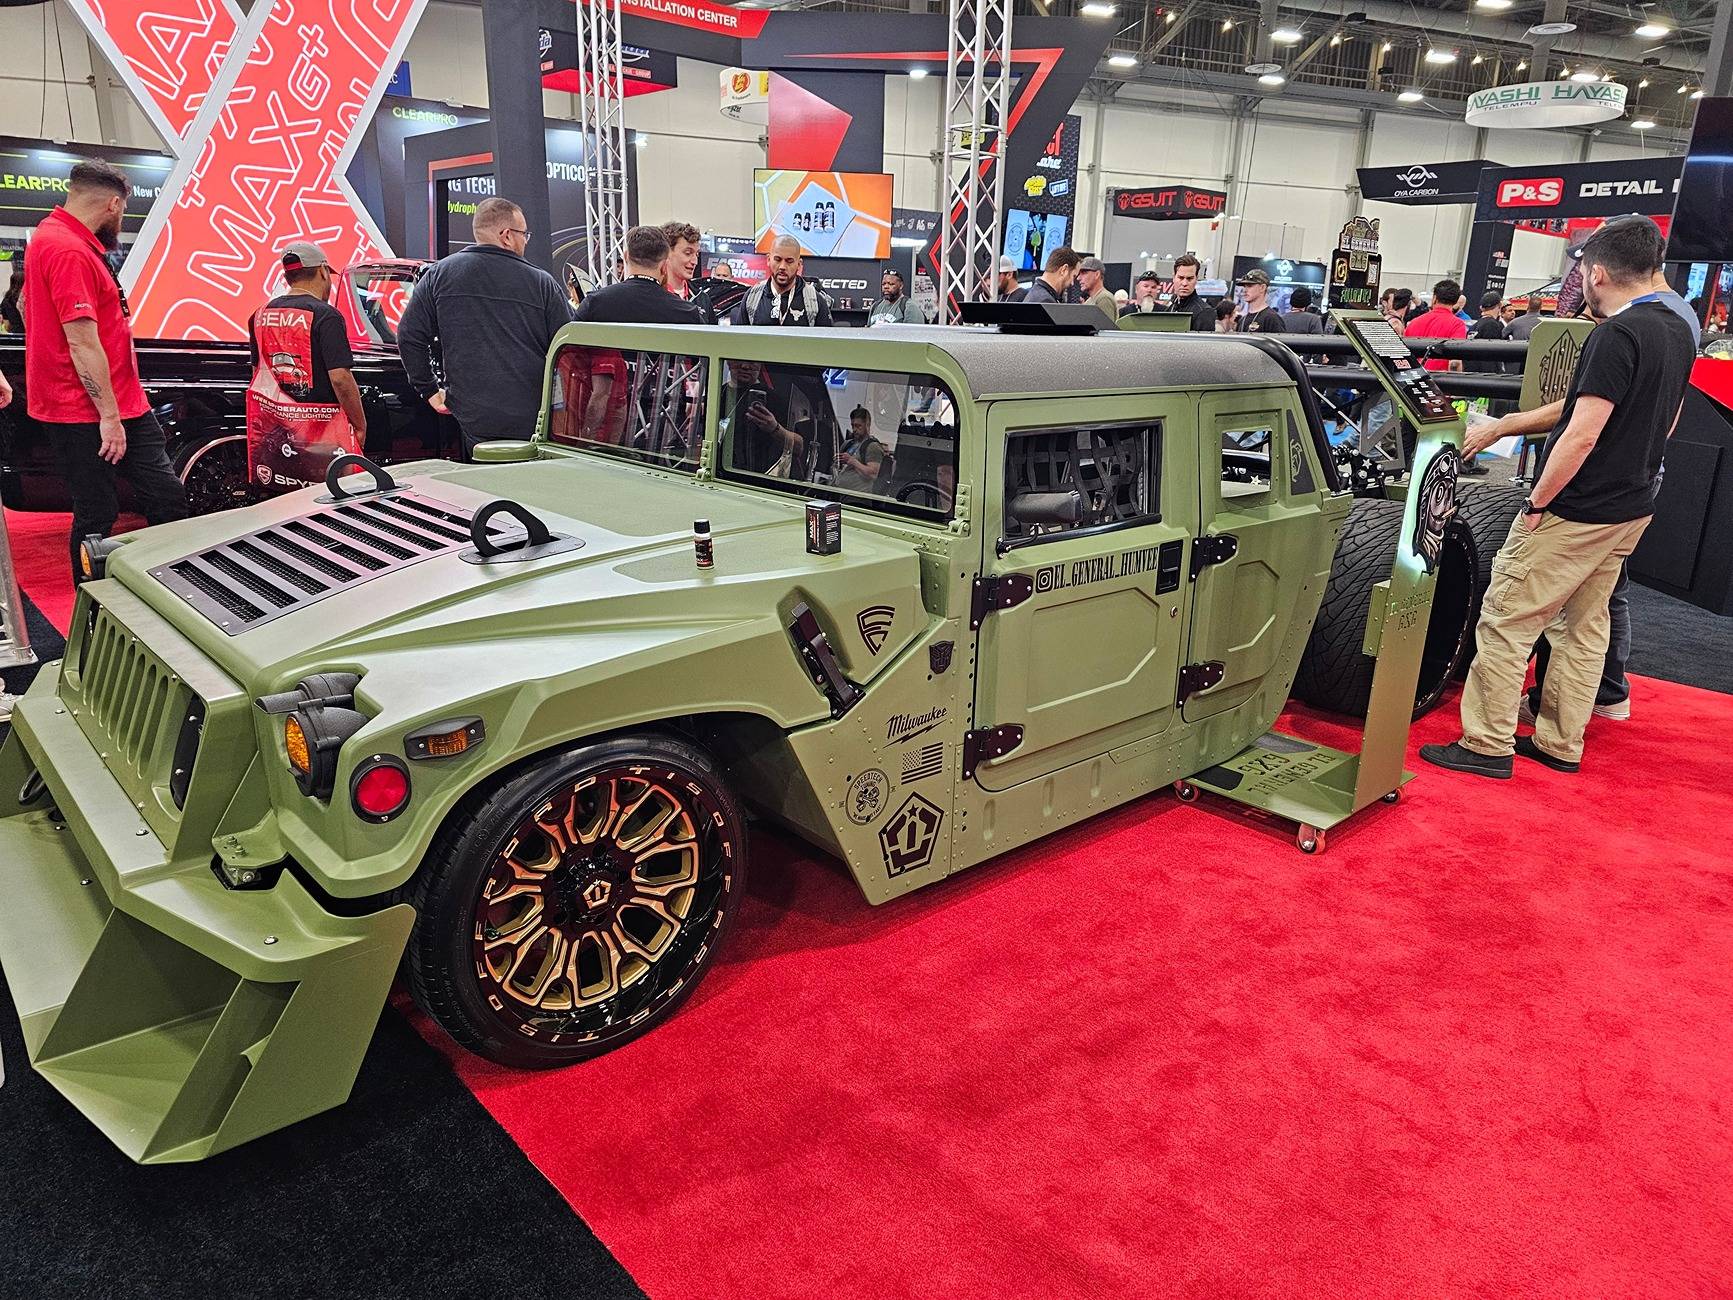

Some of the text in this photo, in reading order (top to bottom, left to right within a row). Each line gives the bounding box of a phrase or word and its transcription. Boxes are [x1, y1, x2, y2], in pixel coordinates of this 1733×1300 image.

[696, 9, 738, 28] CENTER
[1469, 86, 1541, 109] AYASHI
[1483, 100, 1538, 111] TELEMPU
[392, 106, 458, 126] CLEARPRO
[0, 174, 70, 192] EARPRO
[133, 186, 153, 198] New
[466, 176, 496, 195] TECH
[1408, 188, 1439, 196] CARBON
[1500, 181, 1561, 203] P&S
[1578, 179, 1663, 198] DETAIL
[1131, 191, 1177, 208] GSUIT
[1193, 193, 1225, 211] GSUIT
[261, 311, 308, 330] SEMA
[1052, 546, 1159, 590] EL_GENERAL_HUMVEE
[884, 706, 948, 739] Milwaukee
[853, 772, 883, 790] SPEEDTECH
